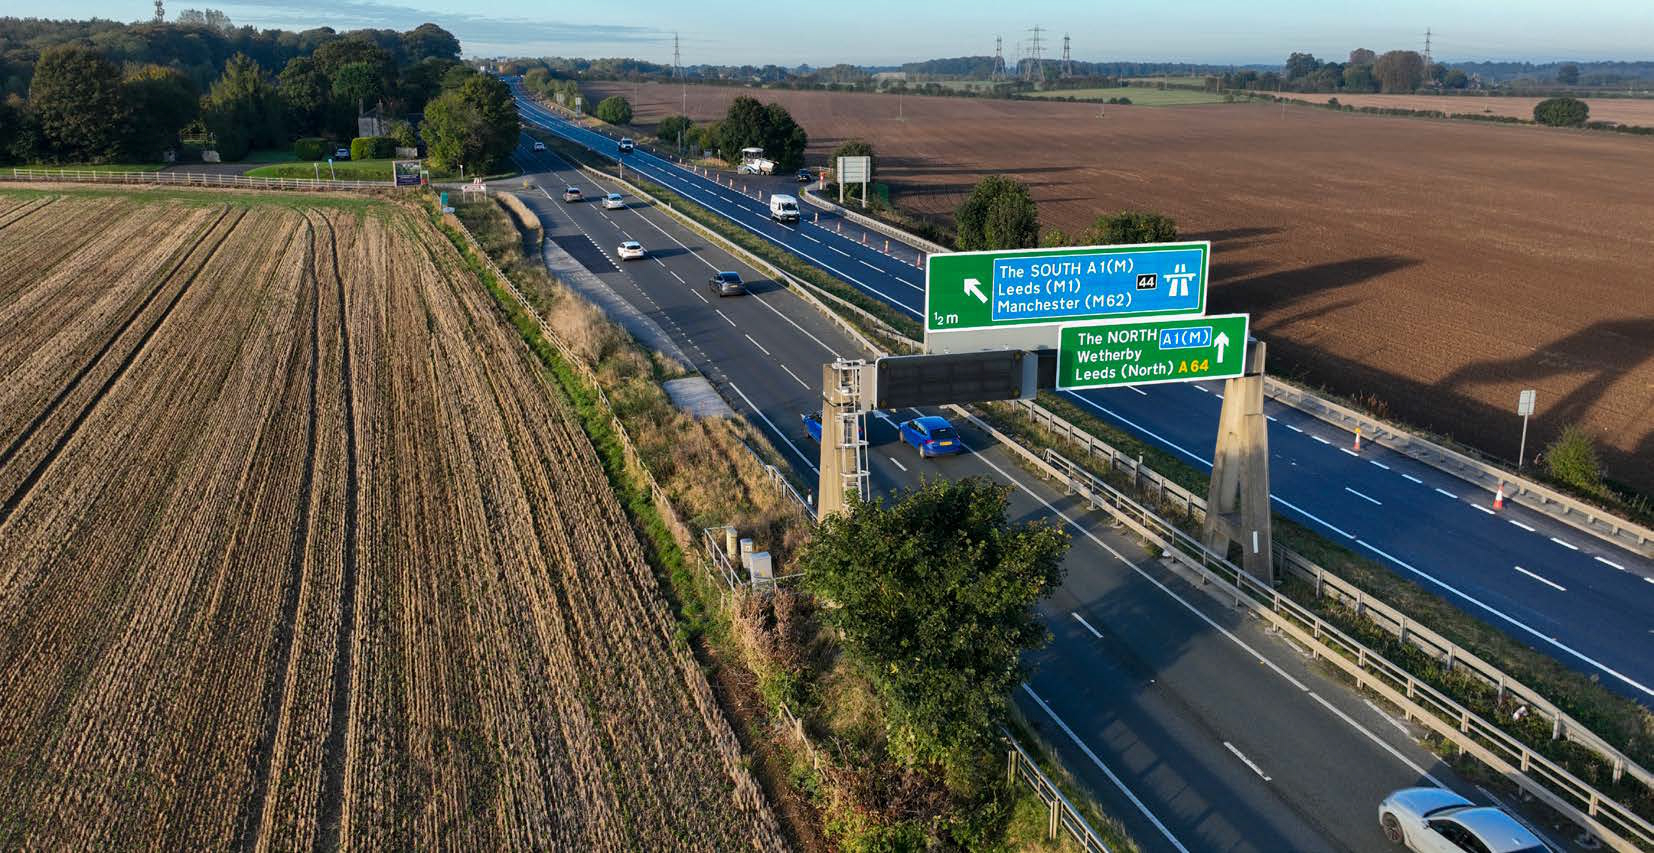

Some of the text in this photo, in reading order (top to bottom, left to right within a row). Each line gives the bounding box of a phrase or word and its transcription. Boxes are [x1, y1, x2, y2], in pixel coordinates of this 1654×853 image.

[999, 266, 1025, 279] The
[1031, 263, 1081, 278] SOUTH
[998, 279, 1081, 296] Leeds (M1)
[1138, 277, 1155, 288] 44
[997, 293, 1132, 314] Manchester (M62)
[946, 314, 959, 324] m
[1077, 333, 1103, 346] The
[1107, 329, 1158, 344] NORTH
[1077, 348, 1142, 364] Wetherby
[1075, 367, 1116, 381] Leeds
[1121, 363, 1174, 379] (North)
